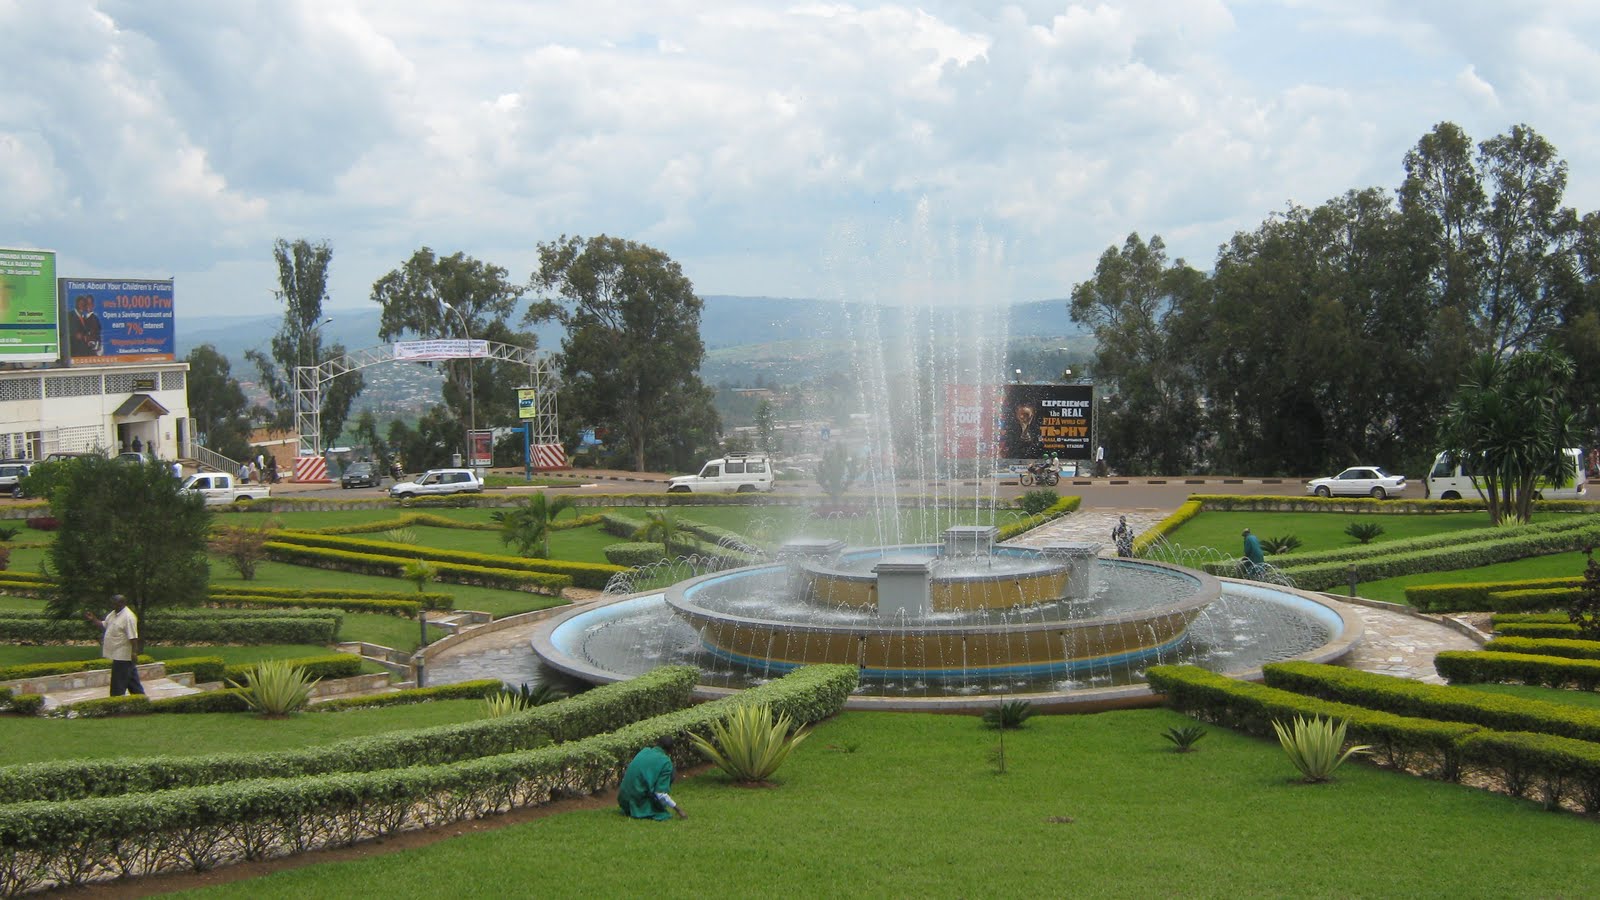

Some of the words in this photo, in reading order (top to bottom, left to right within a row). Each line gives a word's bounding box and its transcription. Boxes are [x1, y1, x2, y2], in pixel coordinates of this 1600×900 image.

[68, 281, 86, 290] Think
[86, 282, 106, 290] About
[107, 282, 121, 290] Your
[122, 282, 152, 291] Children's
[116, 295, 151, 308] 10,000
[153, 296, 171, 308] Frw
[127, 323, 144, 335] 7%
[1062, 408, 1083, 417] REAL
[1040, 427, 1088, 436] TROPHY
